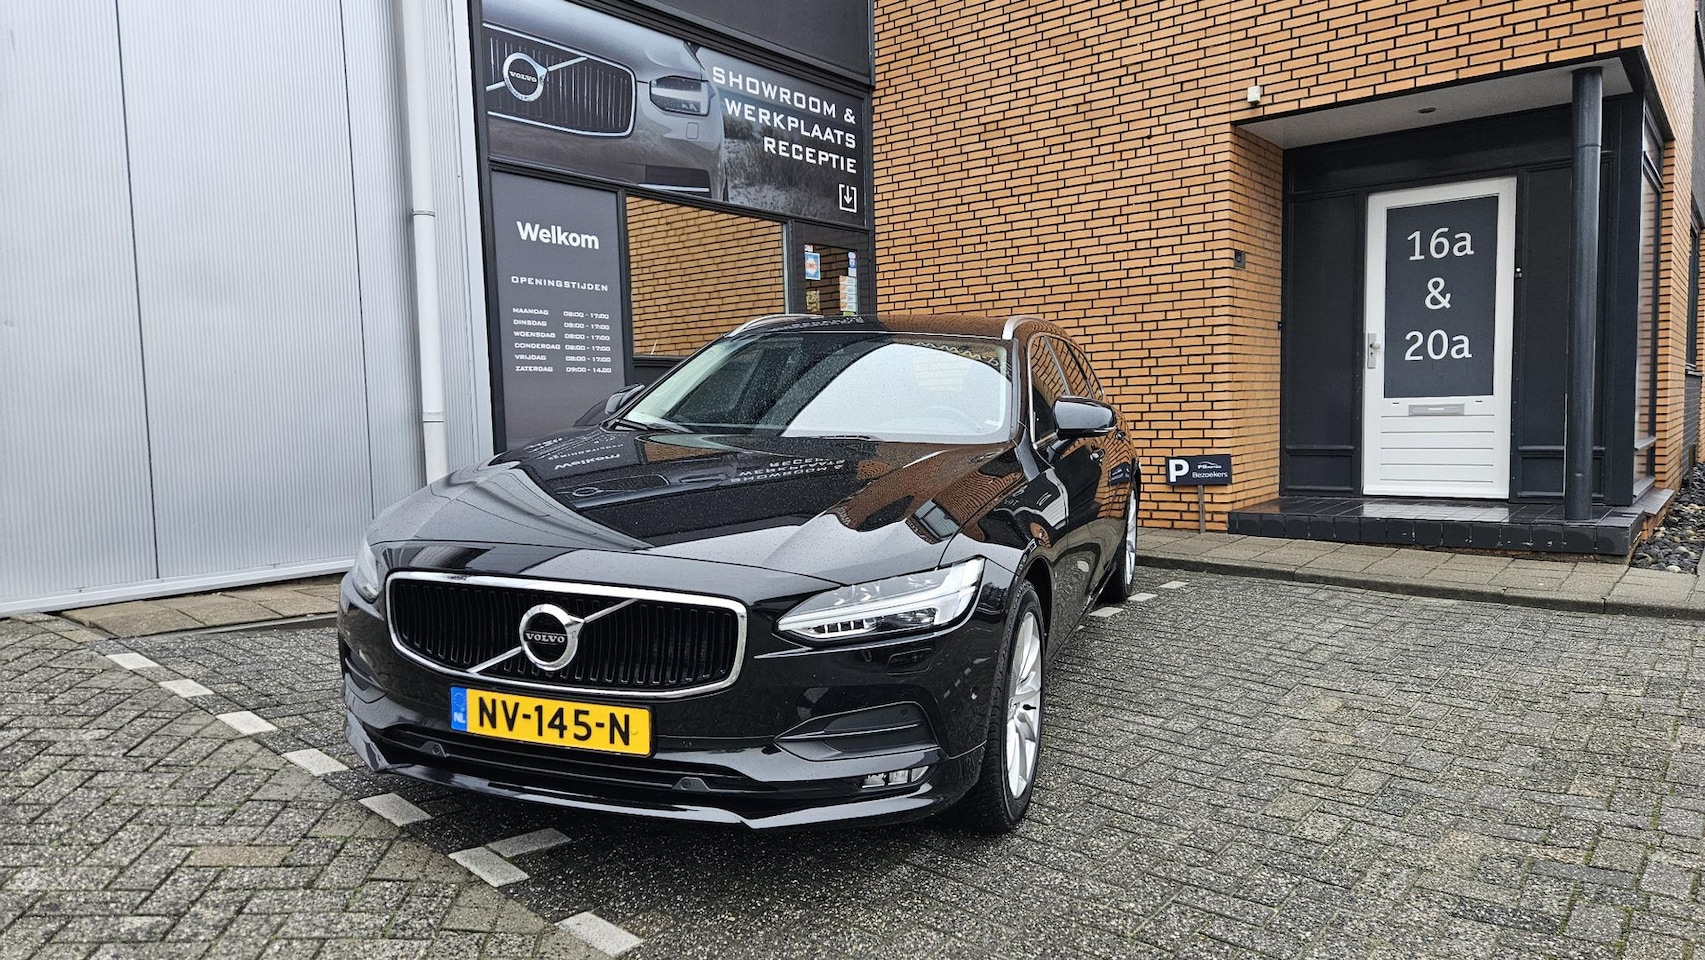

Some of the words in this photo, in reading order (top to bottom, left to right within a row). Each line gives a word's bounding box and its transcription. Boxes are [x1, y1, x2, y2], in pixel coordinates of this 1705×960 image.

[509, 70, 538, 83] VOLVO
[712, 66, 836, 118] SHOWROOM
[843, 107, 856, 124] &
[724, 98, 856, 149] WERKPLAATS
[763, 136, 857, 174] RECEPTIE
[516, 221, 600, 250] Welkom
[1406, 227, 1475, 260] 16a
[511, 275, 609, 292] OPENINGSTIJDEN
[1424, 277, 1451, 310] &
[512, 307, 549, 315] MAANDAG
[514, 342, 561, 350] DONDERDAG
[1404, 329, 1473, 361] 20a
[1168, 459, 1190, 483] P
[1192, 470, 1229, 478] Bezoekers
[525, 632, 566, 644] VOLVO
[453, 711, 467, 724] NL
[478, 696, 631, 746] NV-145-N
